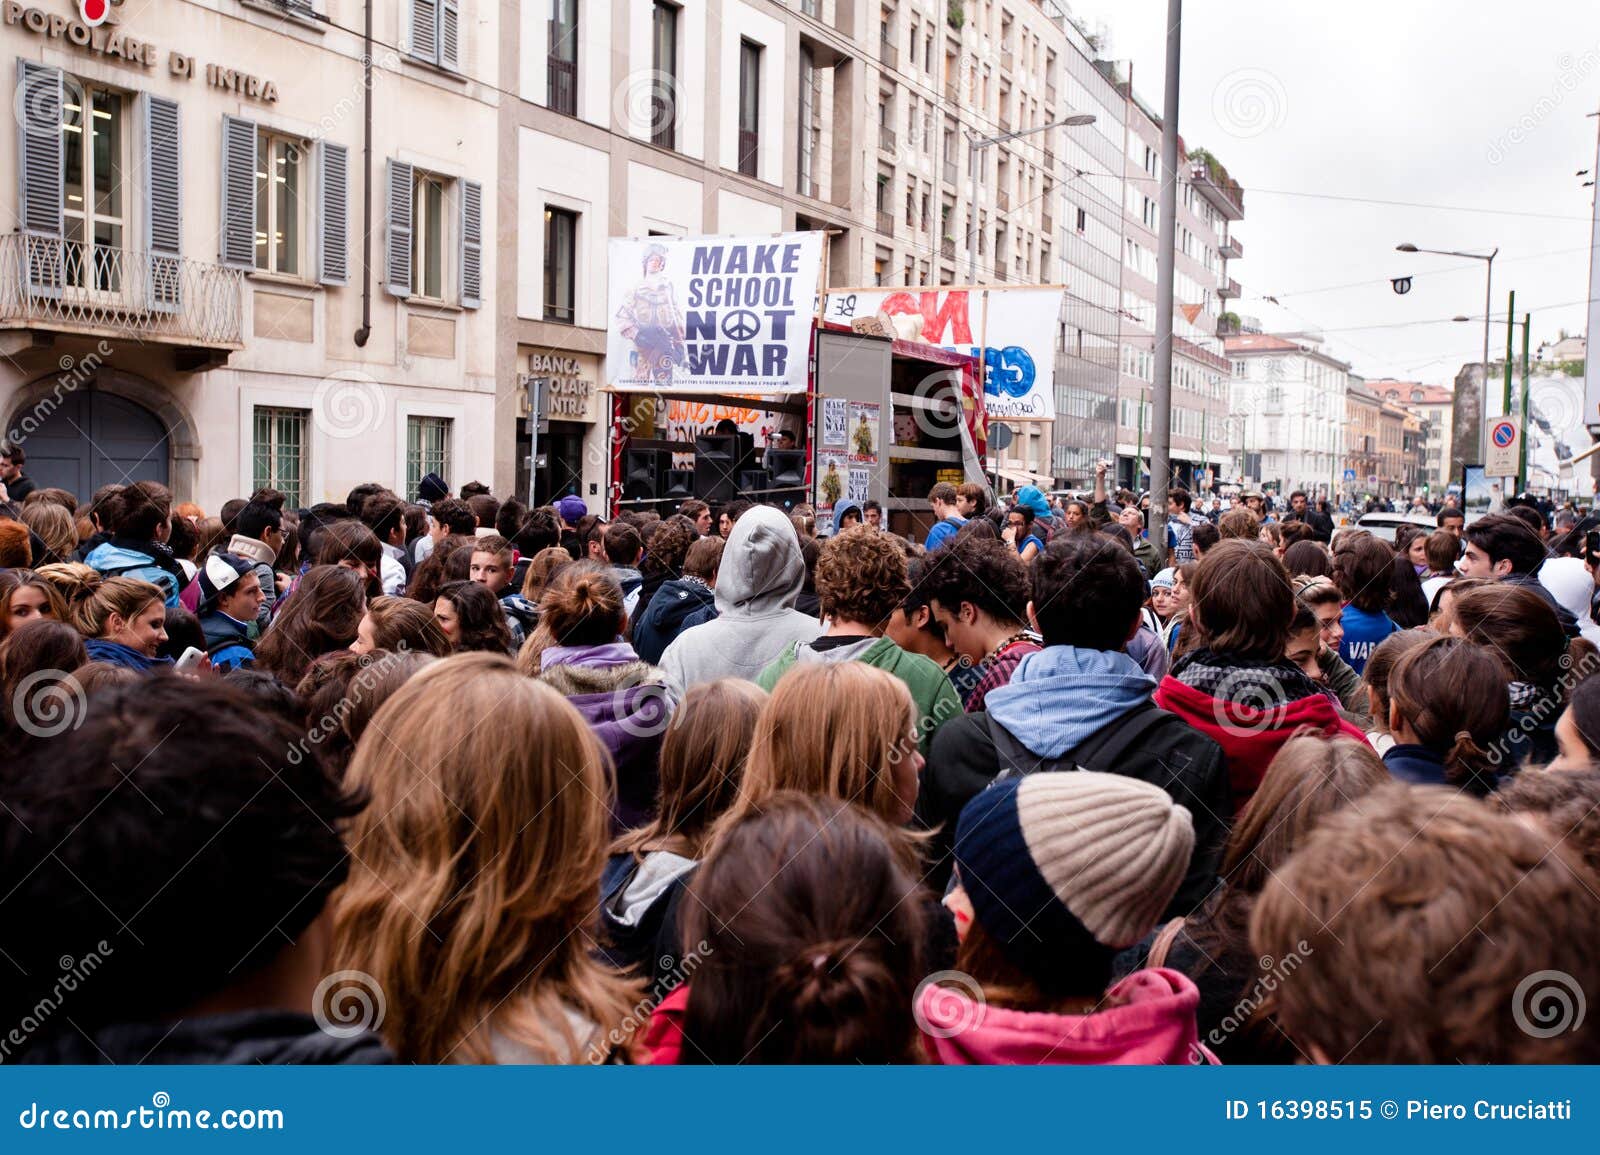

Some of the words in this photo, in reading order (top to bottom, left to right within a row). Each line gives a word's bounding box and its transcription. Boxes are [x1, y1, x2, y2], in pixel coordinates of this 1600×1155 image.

[4, 2, 157, 67] POPOLARE
[169, 51, 196, 80] DI
[206, 63, 280, 103] INTRA
[691, 243, 801, 275] MAKE
[688, 277, 794, 308] SCHOOL
[530, 353, 582, 375] BANCA
[687, 344, 788, 377] WAR
[518, 373, 595, 397] POLARE
